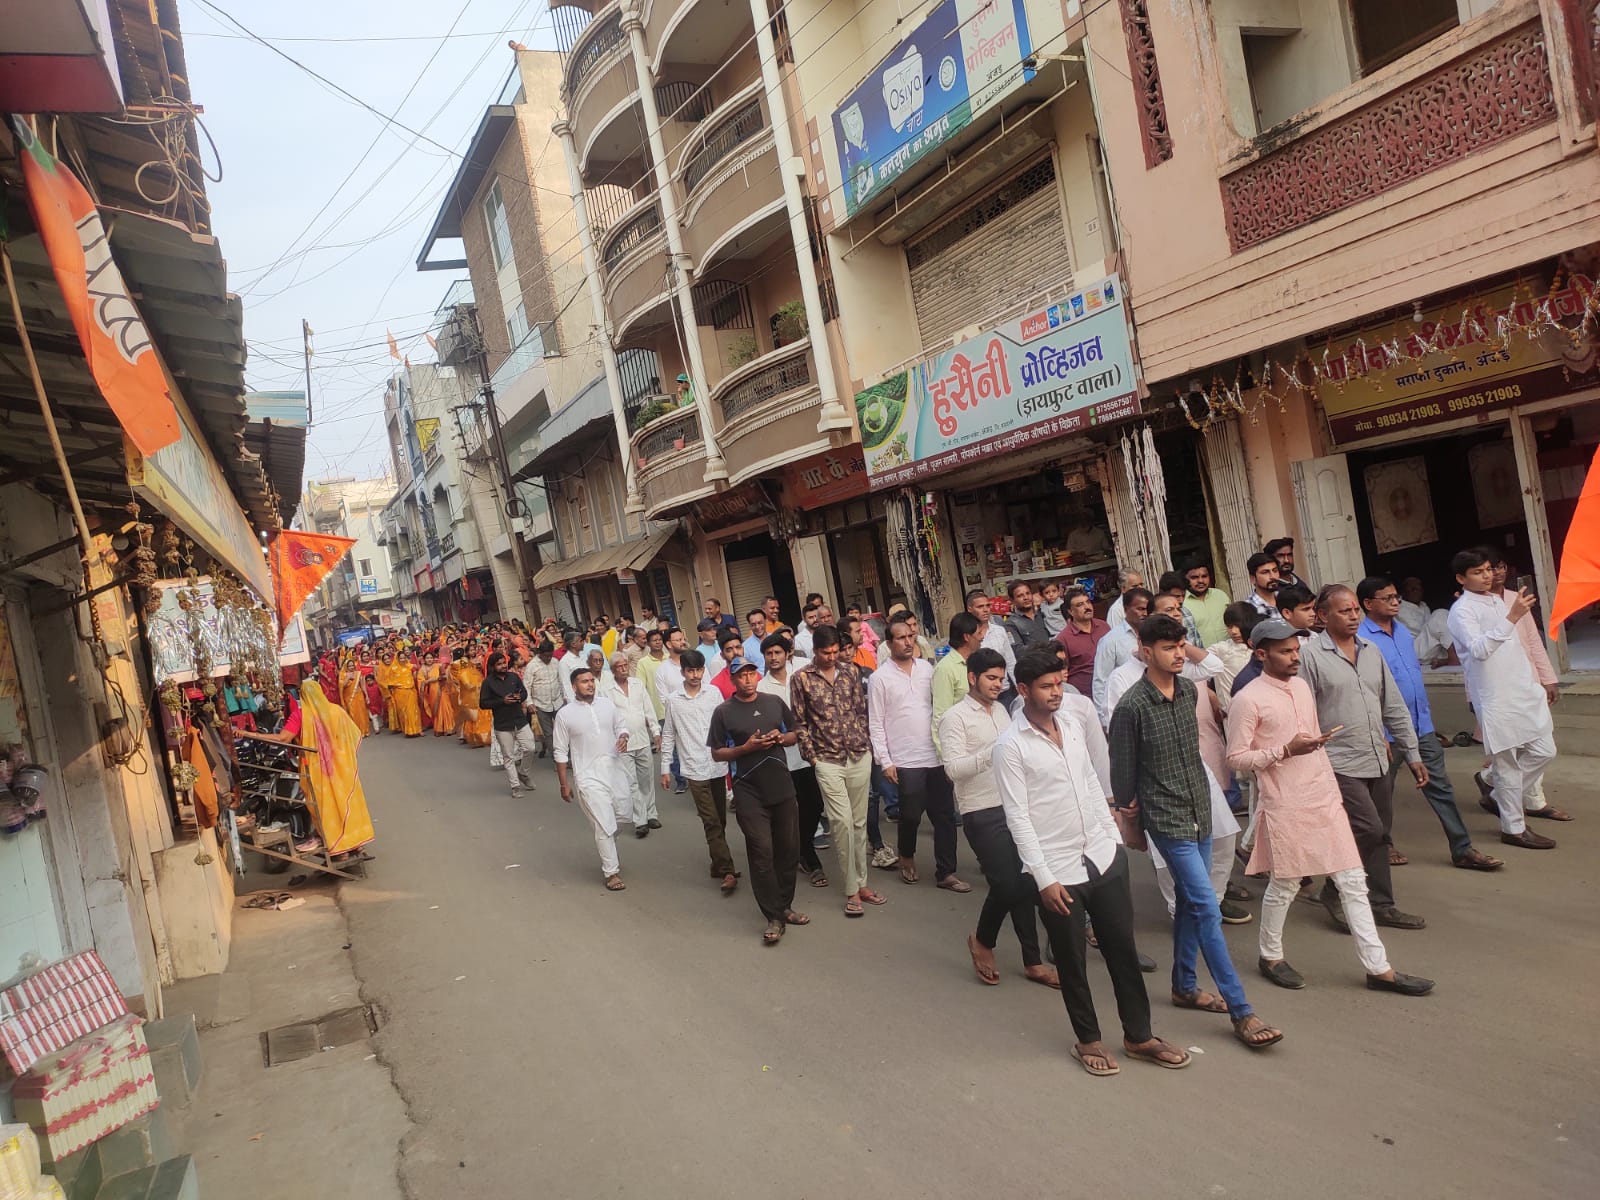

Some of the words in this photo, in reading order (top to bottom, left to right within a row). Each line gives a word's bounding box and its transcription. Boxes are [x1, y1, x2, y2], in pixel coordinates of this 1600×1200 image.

[890, 75, 922, 111] Osiya
[905, 110, 923, 132] चाय
[913, 138, 922, 153] का
[1023, 319, 1047, 337] Anchor
[928, 338, 1012, 437] हुसैनी
[1020, 335, 1104, 389] प्रोव्हिजन
[1076, 363, 1121, 396] वाला)
[1376, 411, 1409, 428] 98934
[1448, 393, 1485, 412] 99935
[1485, 384, 1522, 404] 21903
